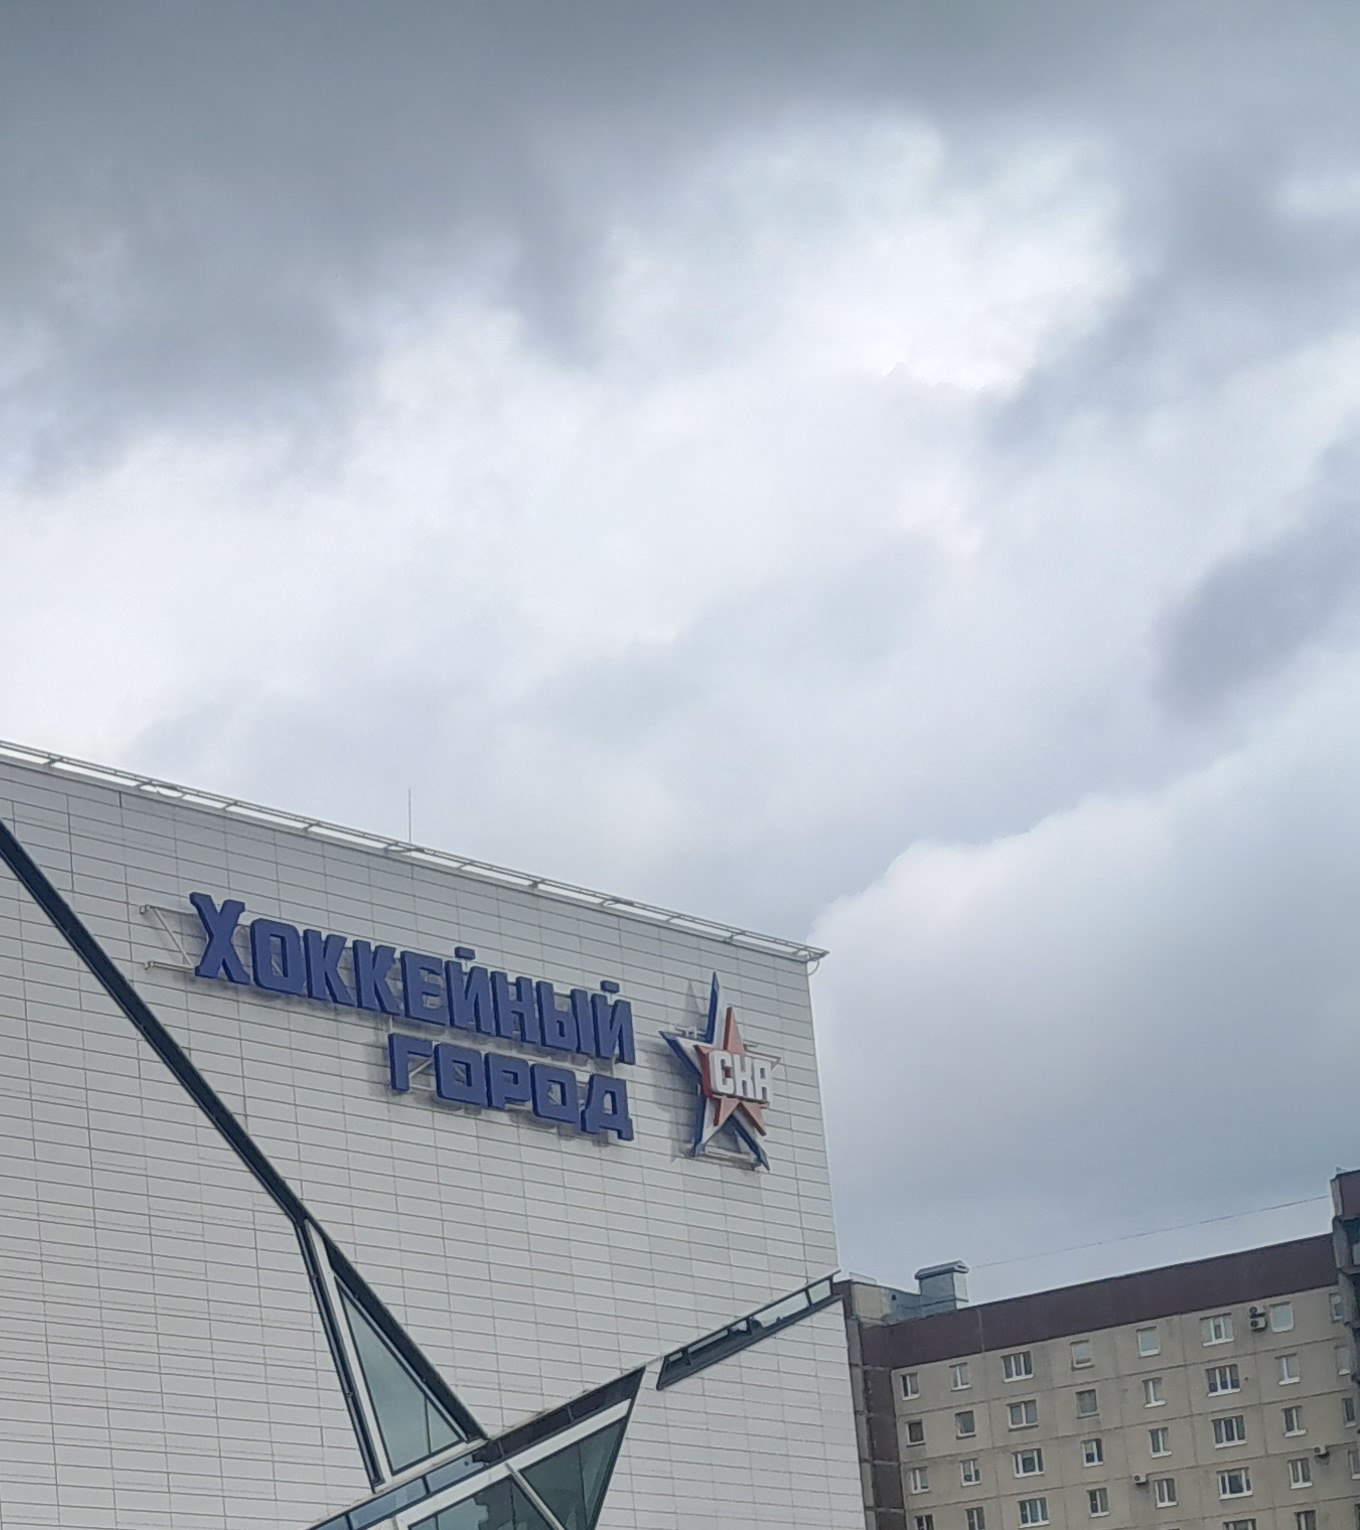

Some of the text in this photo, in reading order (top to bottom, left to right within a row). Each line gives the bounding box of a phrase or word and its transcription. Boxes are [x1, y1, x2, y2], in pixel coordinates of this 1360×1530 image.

[190, 892, 636, 1065] ХОККЕЙНЫЙ
[388, 1032, 635, 1142] ГОРОД
[708, 1048, 774, 1103] СКА
